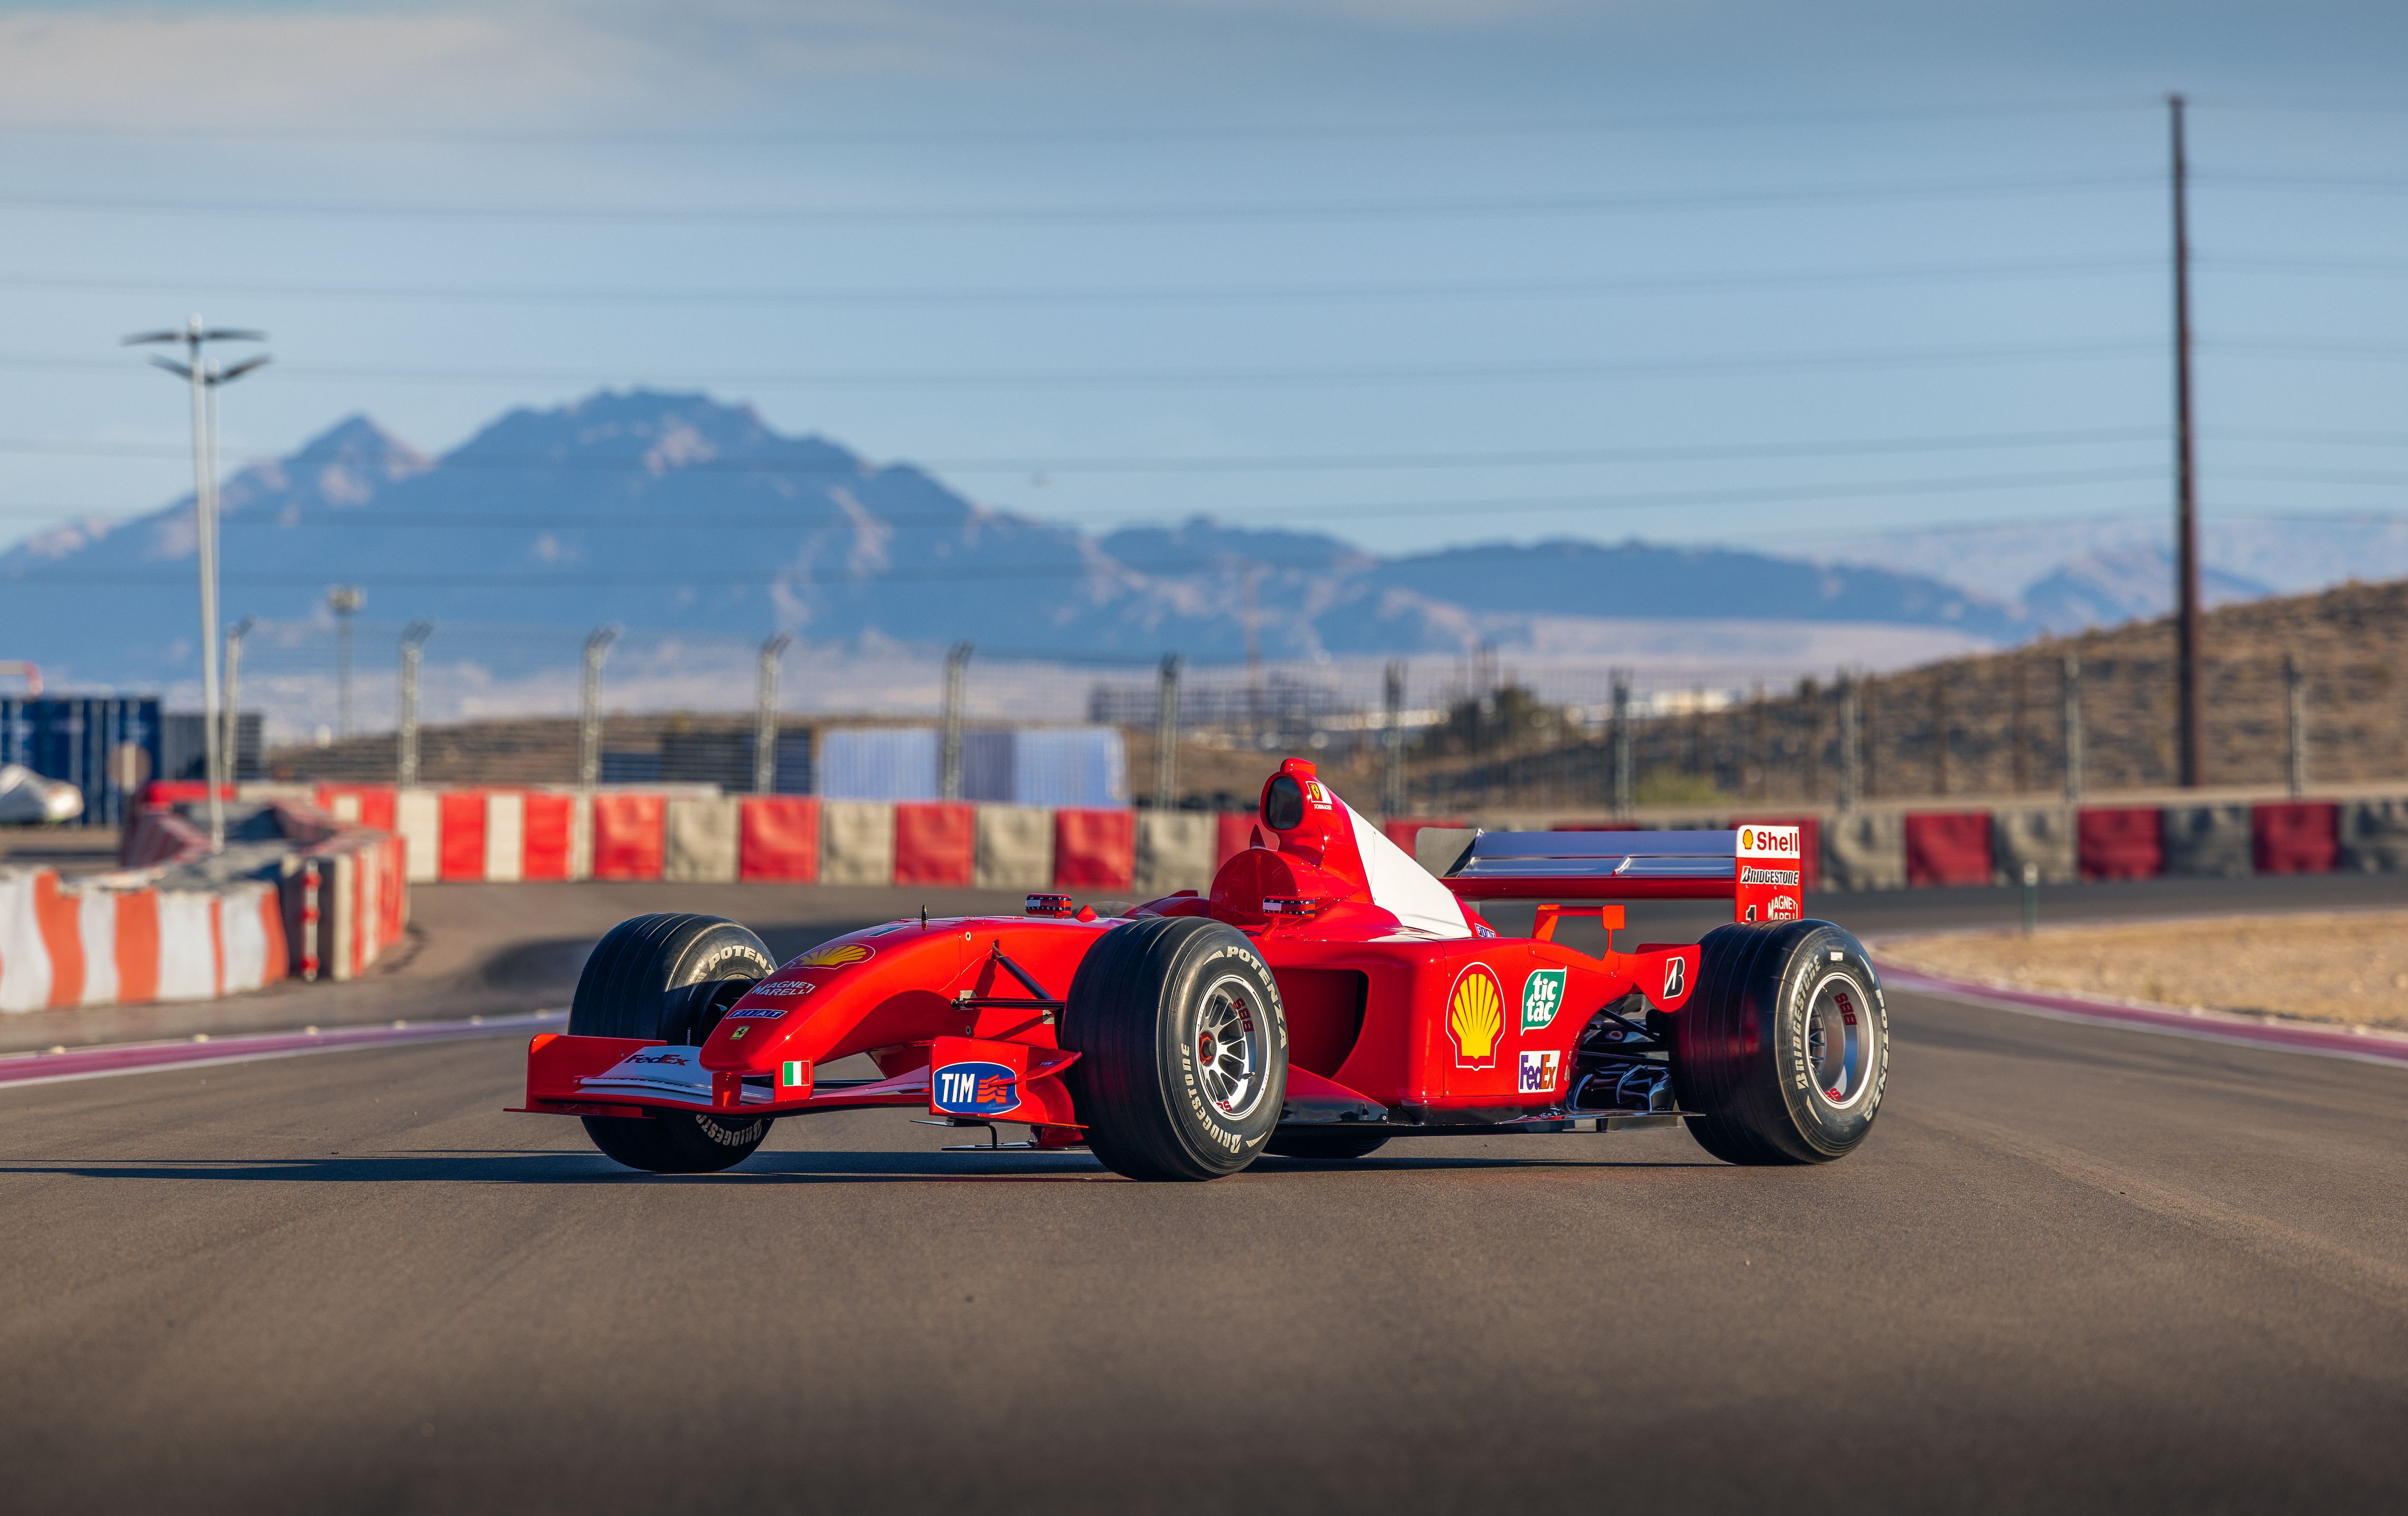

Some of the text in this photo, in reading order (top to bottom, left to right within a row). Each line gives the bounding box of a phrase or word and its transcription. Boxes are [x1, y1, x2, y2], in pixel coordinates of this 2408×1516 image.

[1757, 831, 1798, 852] Shell
[1740, 866, 1799, 885] BRIDGESTONE
[1746, 905, 1756, 921] 1
[1768, 895, 1798, 912] MAGNETI
[1476, 926, 1495, 938] FIAT
[709, 945, 775, 975] POTENZ
[752, 981, 816, 992] MAGNETI
[752, 986, 816, 995] MARELLI
[1227, 946, 1287, 1050] POTENZA
[1533, 973, 1558, 1001] tic
[1233, 998, 1254, 1032] BBS
[1526, 994, 1555, 1022] tac
[1835, 993, 1858, 1025] BBS
[624, 1054, 691, 1066] FedEx
[1520, 1054, 1556, 1090] FedEx
[941, 1073, 975, 1103] TIM
[1181, 1043, 1242, 1153] BRIDGESTONE
